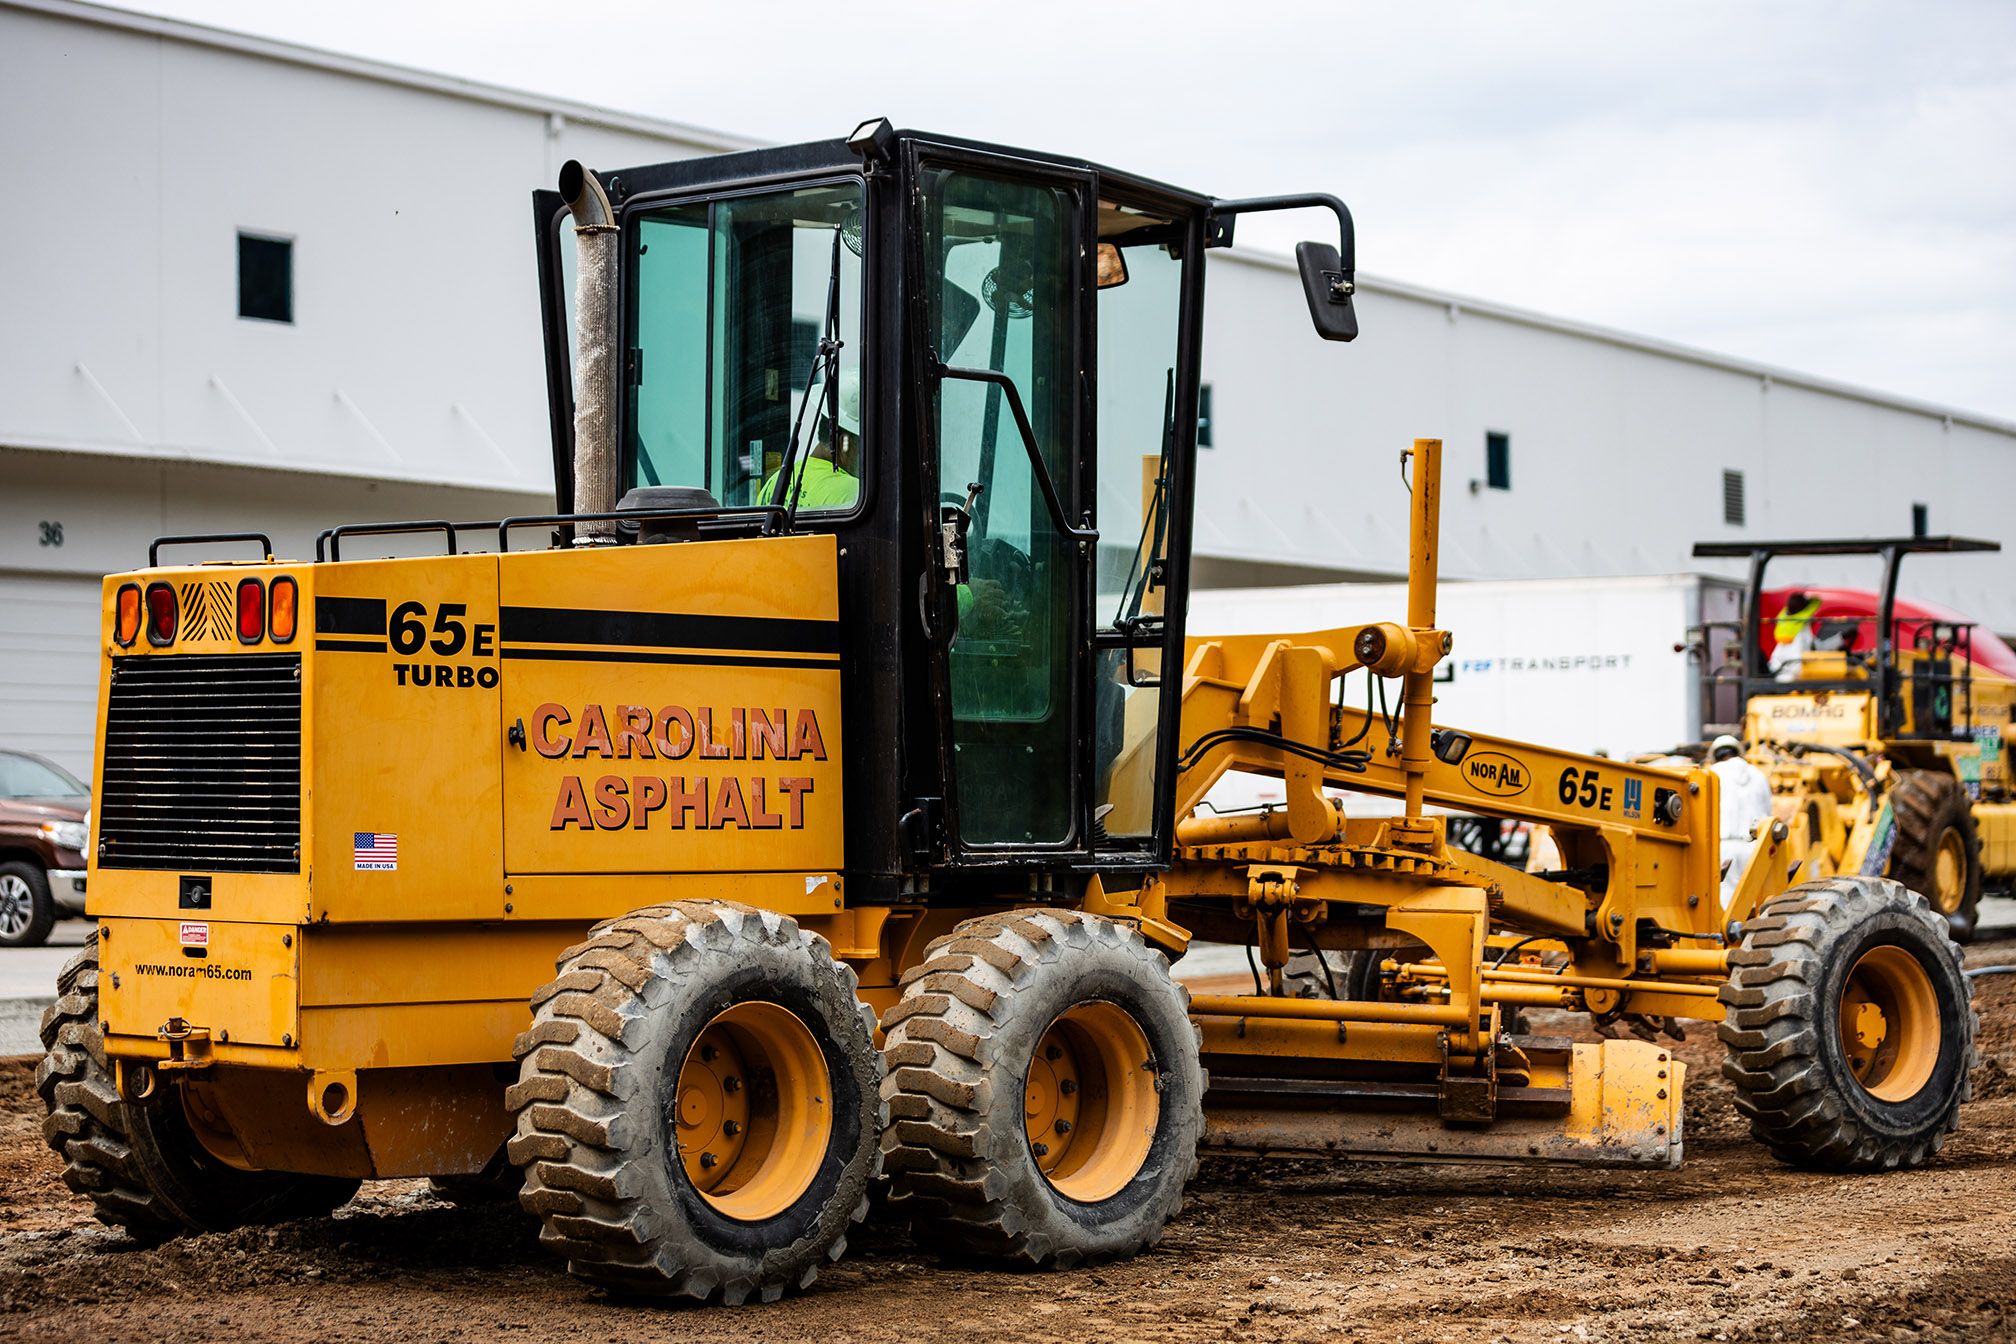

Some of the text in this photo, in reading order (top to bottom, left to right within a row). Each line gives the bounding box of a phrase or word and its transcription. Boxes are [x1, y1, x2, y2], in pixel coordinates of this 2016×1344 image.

[38, 520, 64, 548] 36
[1499, 654, 1633, 671] TRANSPORT
[393, 663, 499, 689] TURBO
[1771, 703, 1846, 719] BOMAG
[531, 702, 828, 761] CAROLINA
[550, 775, 814, 831] ASPHALT
[1623, 810, 1641, 819] WILSON
[135, 964, 252, 980] www.noram65.com
